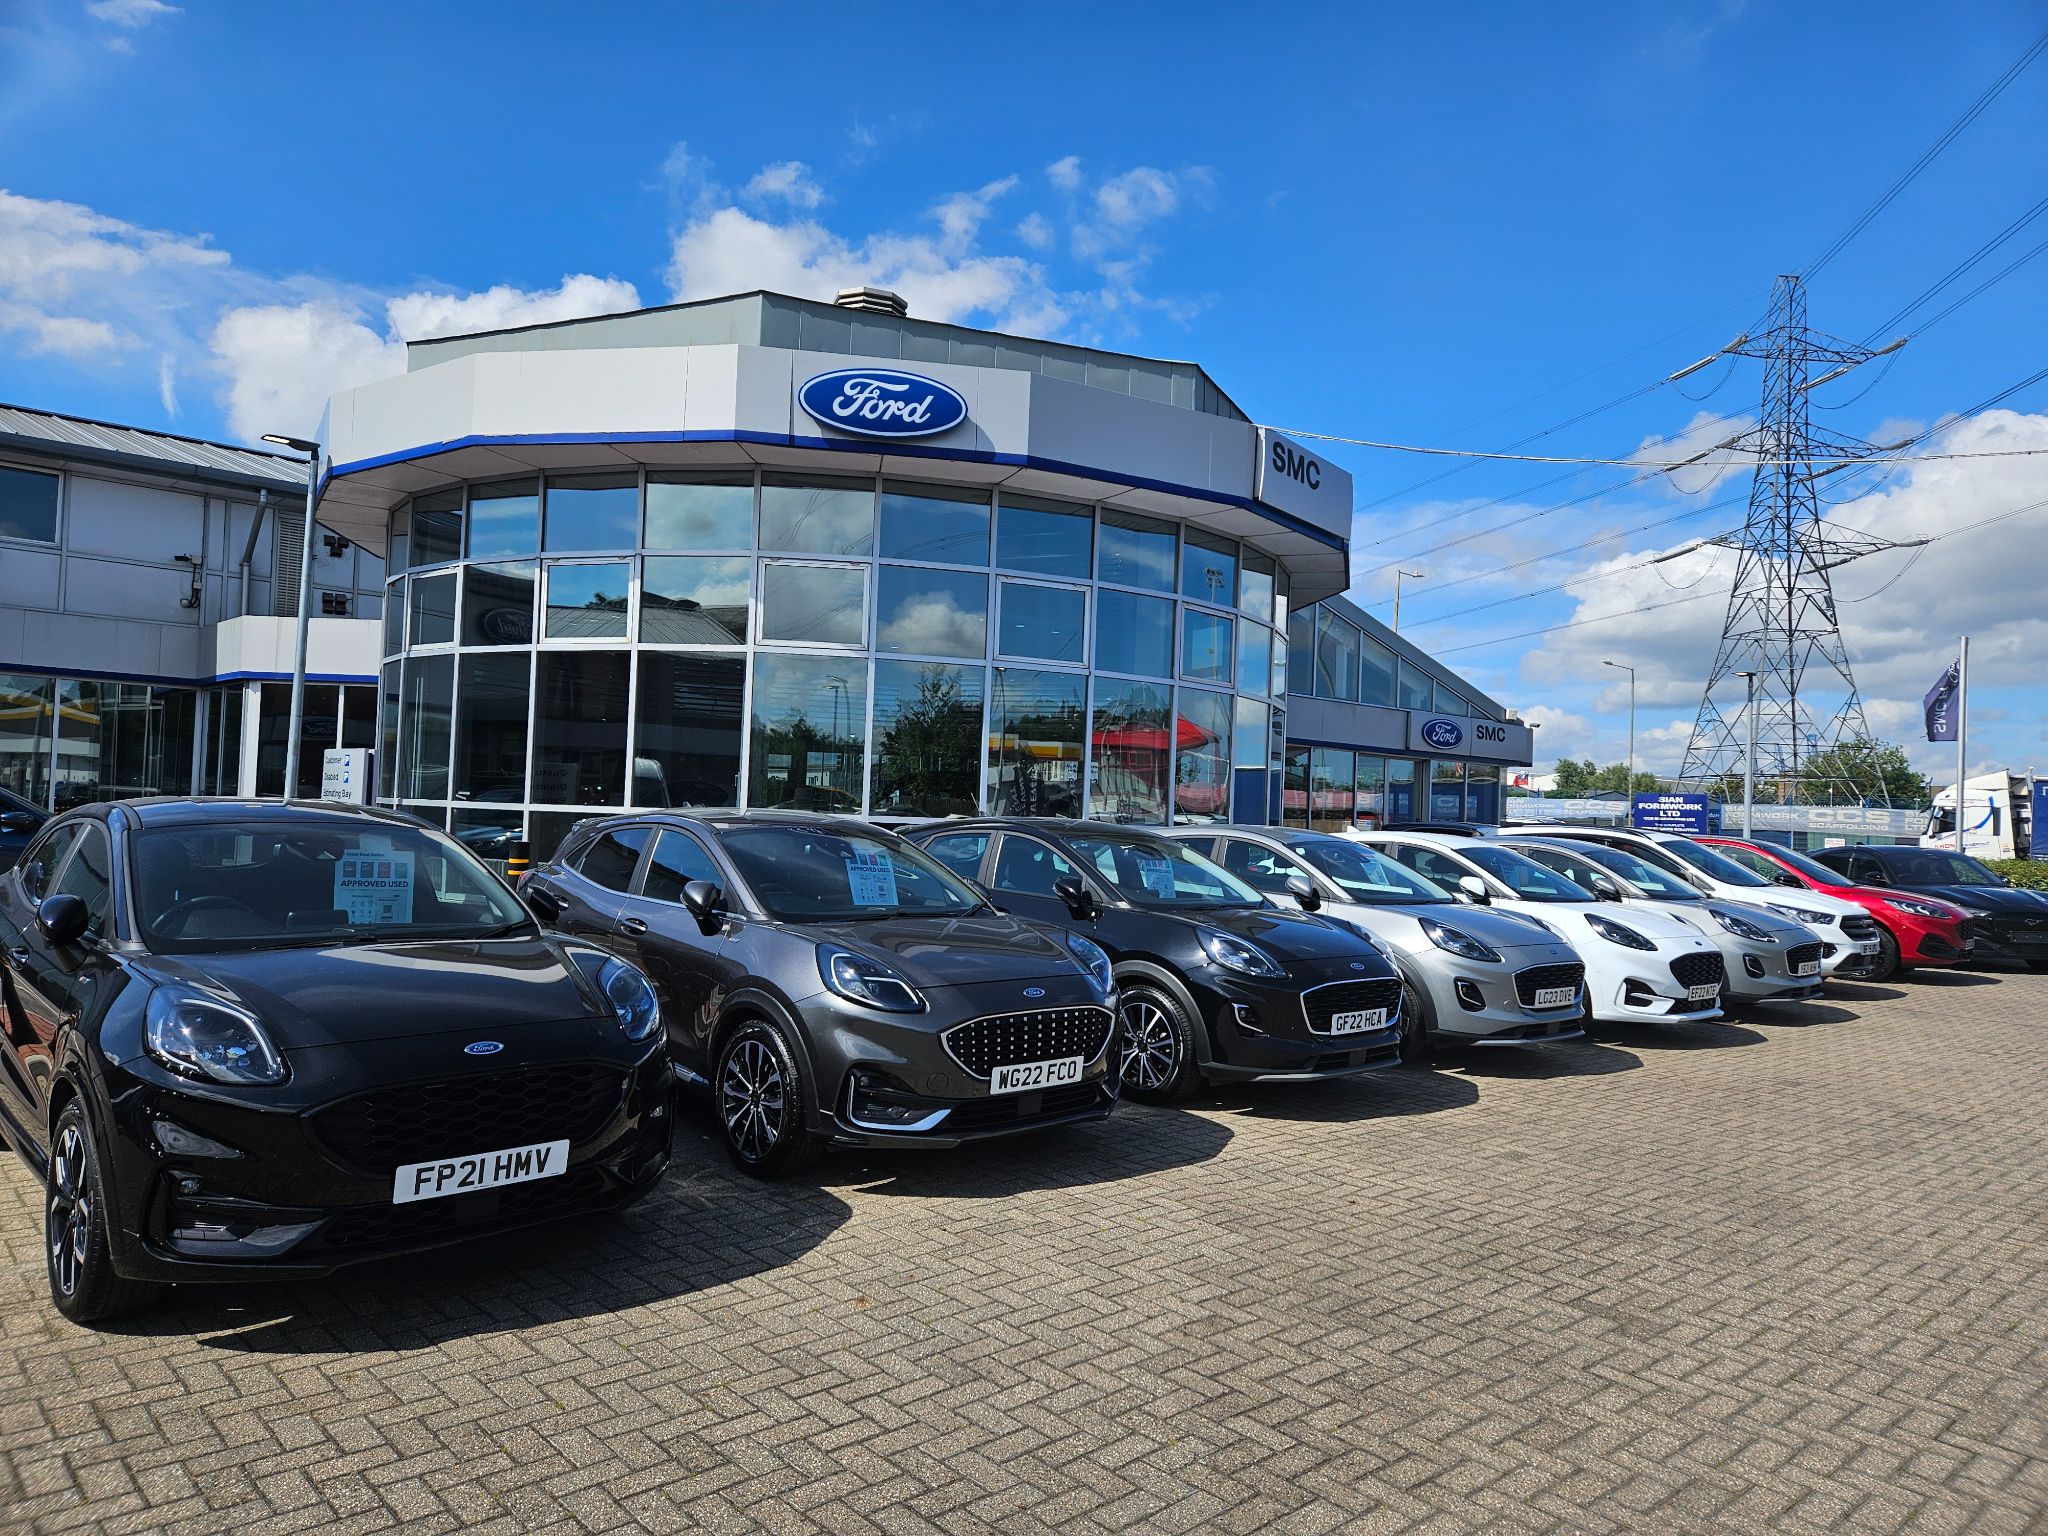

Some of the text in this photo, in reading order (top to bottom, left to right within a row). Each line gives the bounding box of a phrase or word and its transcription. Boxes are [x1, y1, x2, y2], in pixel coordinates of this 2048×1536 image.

[832, 378, 935, 424] Ford
[1272, 441, 1321, 490] SMC
[1432, 723, 1506, 743] Ford SMC
[323, 789, 352, 800] Estimating Bay
[1564, 801, 1626, 811] CCS
[1638, 803, 1703, 811] FORMWORK
[1808, 809, 1890, 824] CCS
[1808, 822, 1889, 831] SCAFFOLDING
[340, 880, 409, 888] APPROVED USED
[1538, 990, 1559, 1005] LG23
[1336, 1010, 1382, 1032] GF22 HCA
[998, 1060, 1078, 1090] WG22 FCO
[413, 1146, 552, 1196] FP21 HMV
